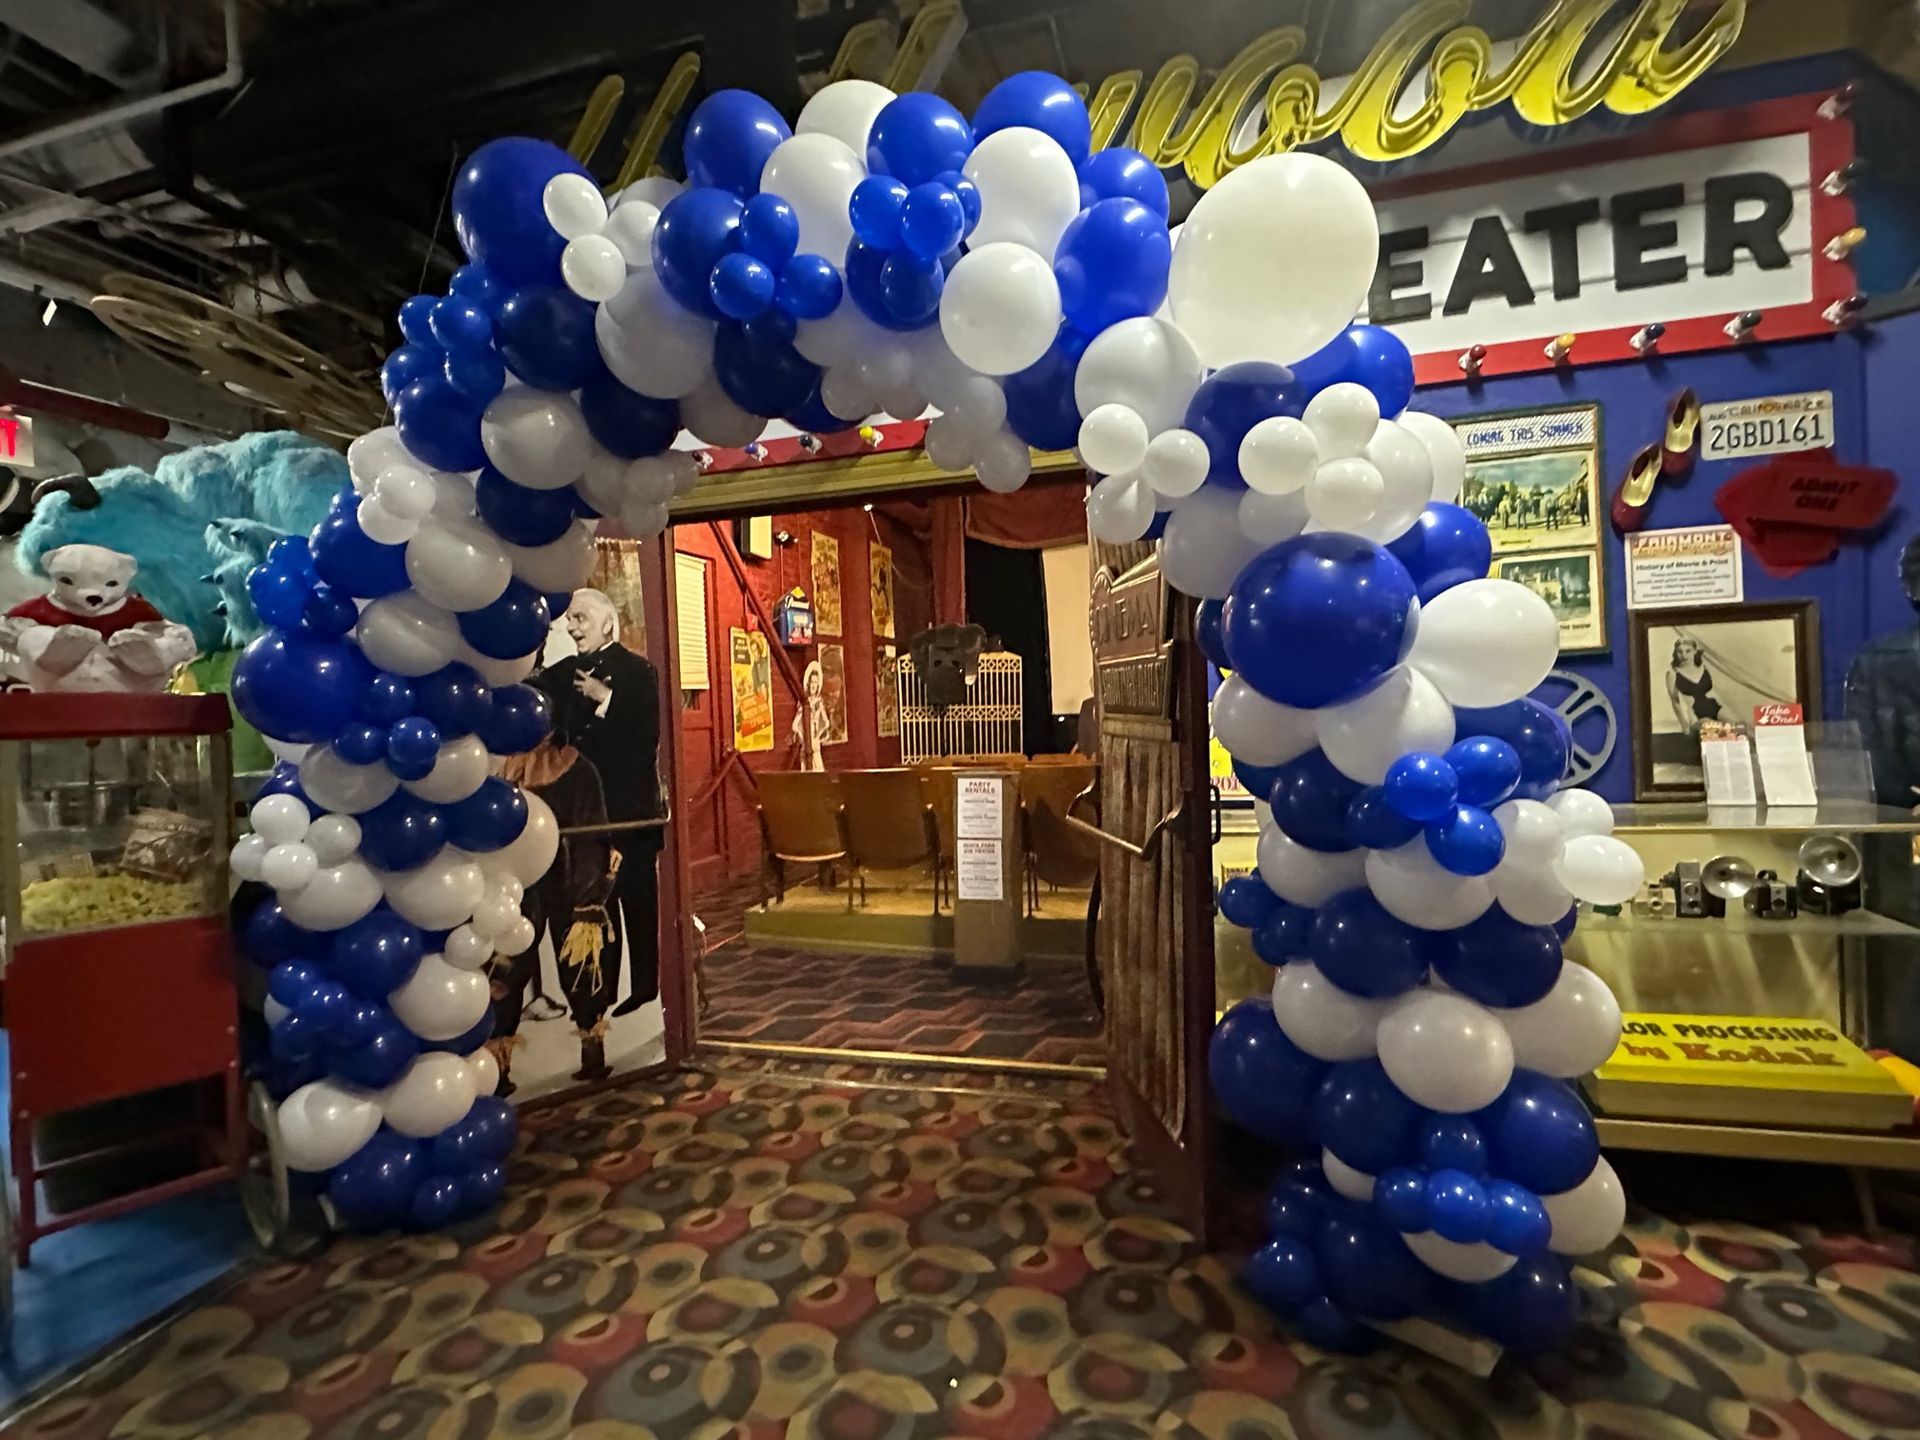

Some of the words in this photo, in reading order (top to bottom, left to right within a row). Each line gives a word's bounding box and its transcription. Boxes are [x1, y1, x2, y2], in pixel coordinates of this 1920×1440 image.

[1368, 173, 1794, 323] EATER
[1710, 413, 1825, 451] 2GBD161
[1790, 477, 1860, 495] ADMIT
[1760, 704, 1791, 715] Take
[1770, 713, 1800, 725] One!
[1621, 1021, 1668, 1037] LOR
[1673, 1023, 1838, 1042] PROCESSING
[1620, 1040, 1671, 1061] by
[1673, 1041, 1848, 1067] Kodak
